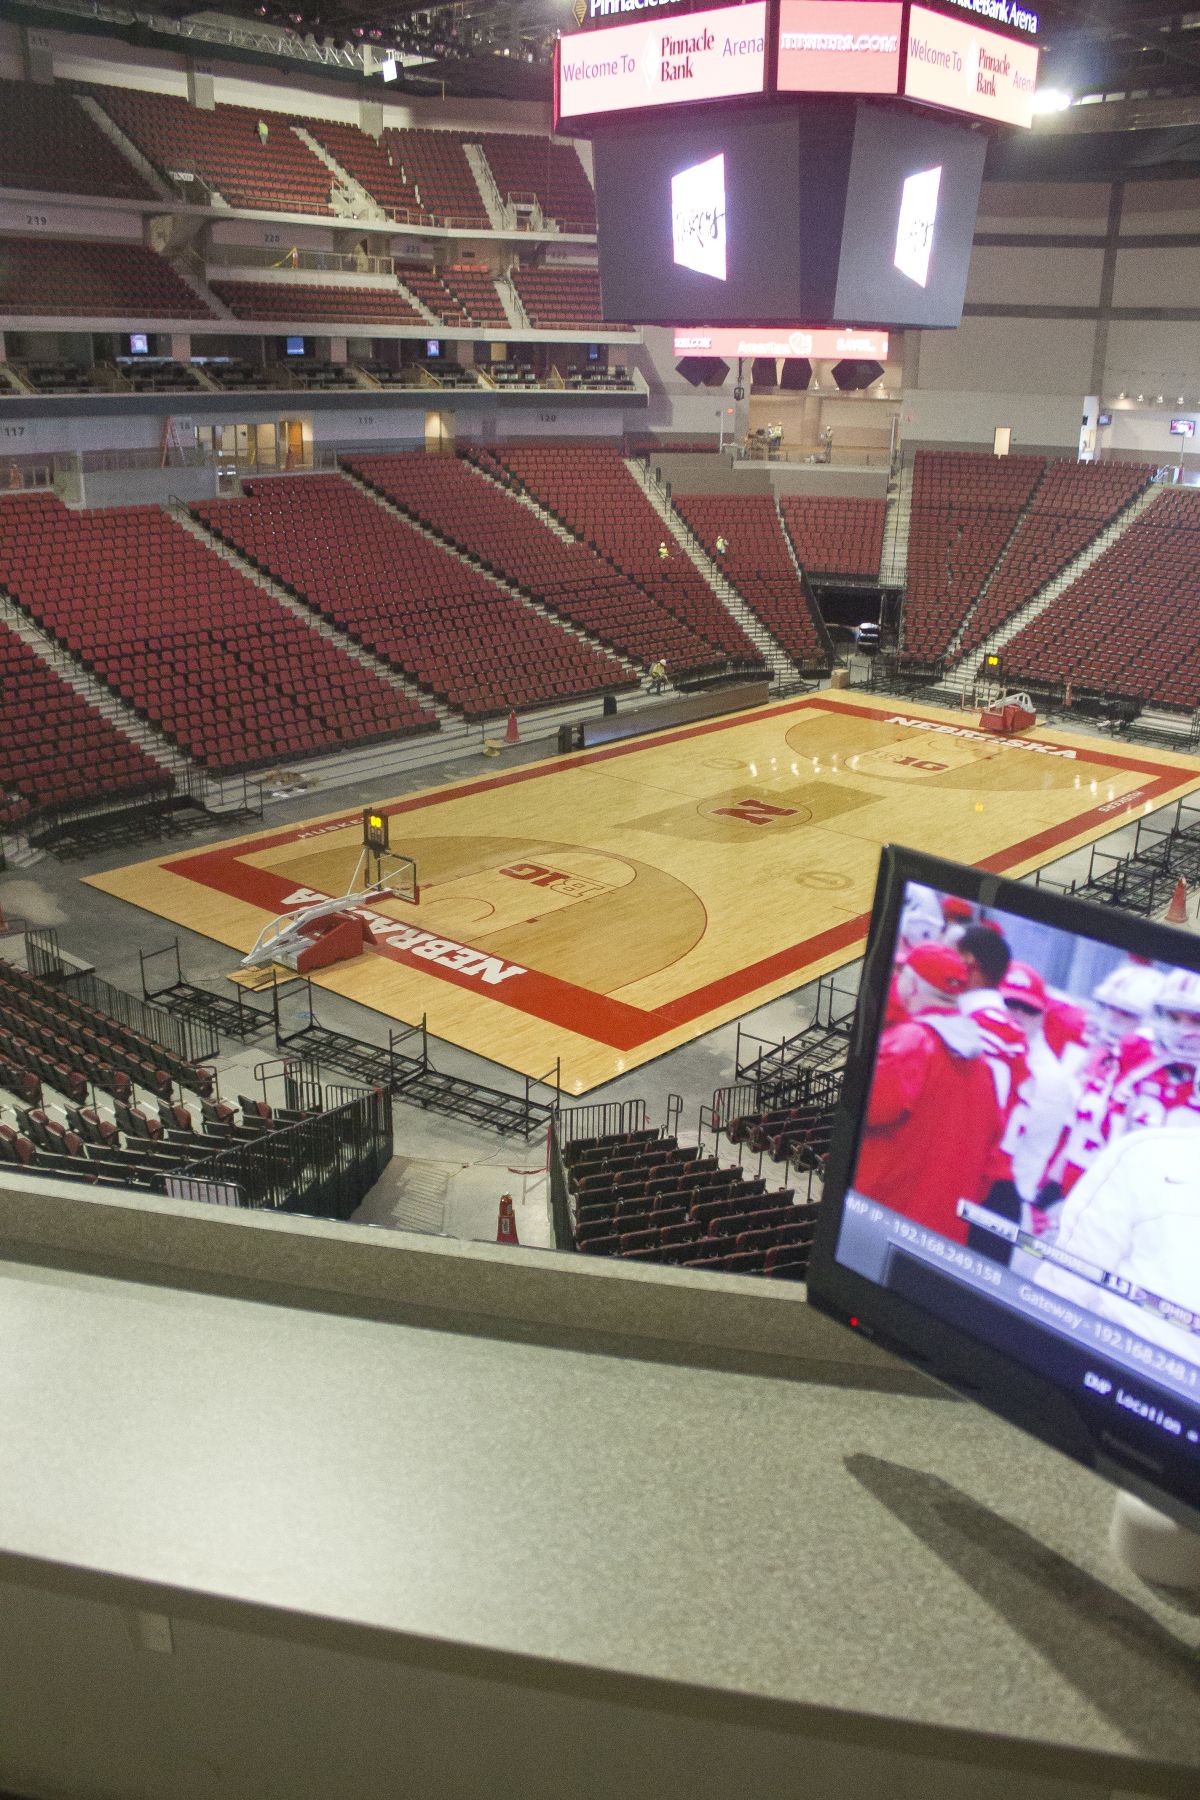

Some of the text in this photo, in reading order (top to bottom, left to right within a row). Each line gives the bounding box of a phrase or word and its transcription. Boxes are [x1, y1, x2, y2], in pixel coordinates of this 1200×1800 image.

[1009, 2, 1038, 33] Arena
[661, 27, 715, 57] Pinnacle
[563, 38, 764, 82] Welcome To Arena
[661, 56, 693, 82] Bank
[910, 37, 1036, 94] Welcome To Arena
[978, 48, 1011, 76] Pinnacle
[976, 72, 997, 97] Bank
[26, 215, 47, 226] 219
[5, 426, 25, 437] 117
[884, 716, 1077, 759] NEBRASKA
[280, 887, 528, 985] NEBRAA
[1020, 1284, 1083, 1330] Gateway
[1115, 1388, 1182, 1435] Location
